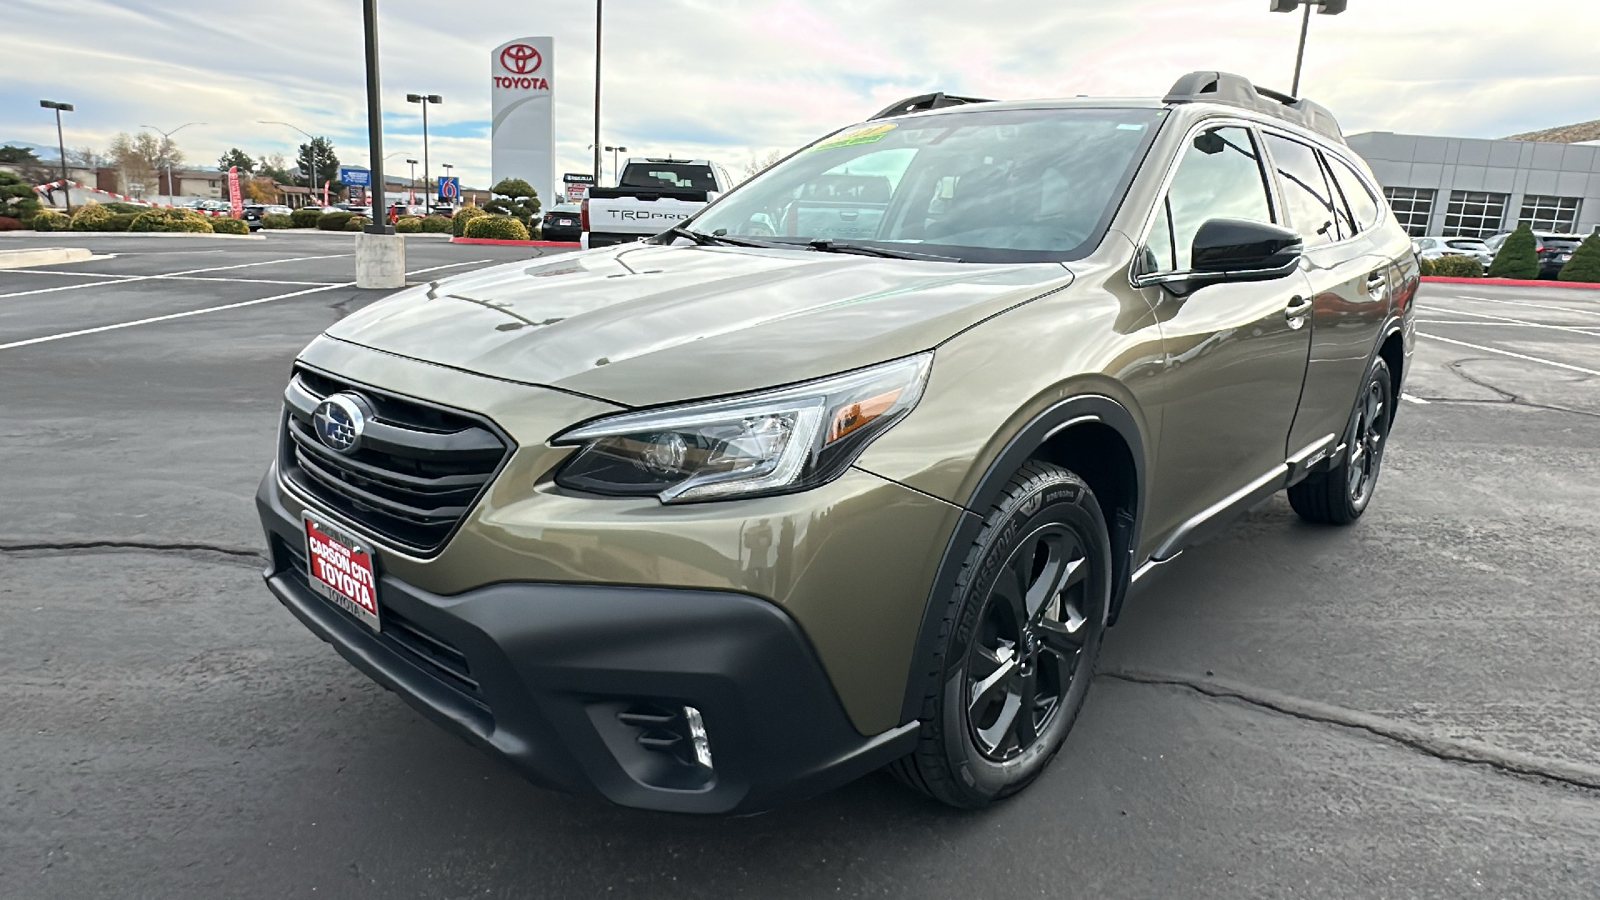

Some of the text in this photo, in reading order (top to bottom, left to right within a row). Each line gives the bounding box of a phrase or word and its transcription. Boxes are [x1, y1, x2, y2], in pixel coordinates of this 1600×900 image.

[493, 76, 549, 90] TOYOTA
[442, 177, 457, 198] 6
[607, 209, 650, 220] TRD
[309, 536, 351, 574] CARSON
[351, 561, 374, 588] CITY
[318, 558, 374, 610] TOYOTA
[327, 586, 361, 616] TOYOTA
